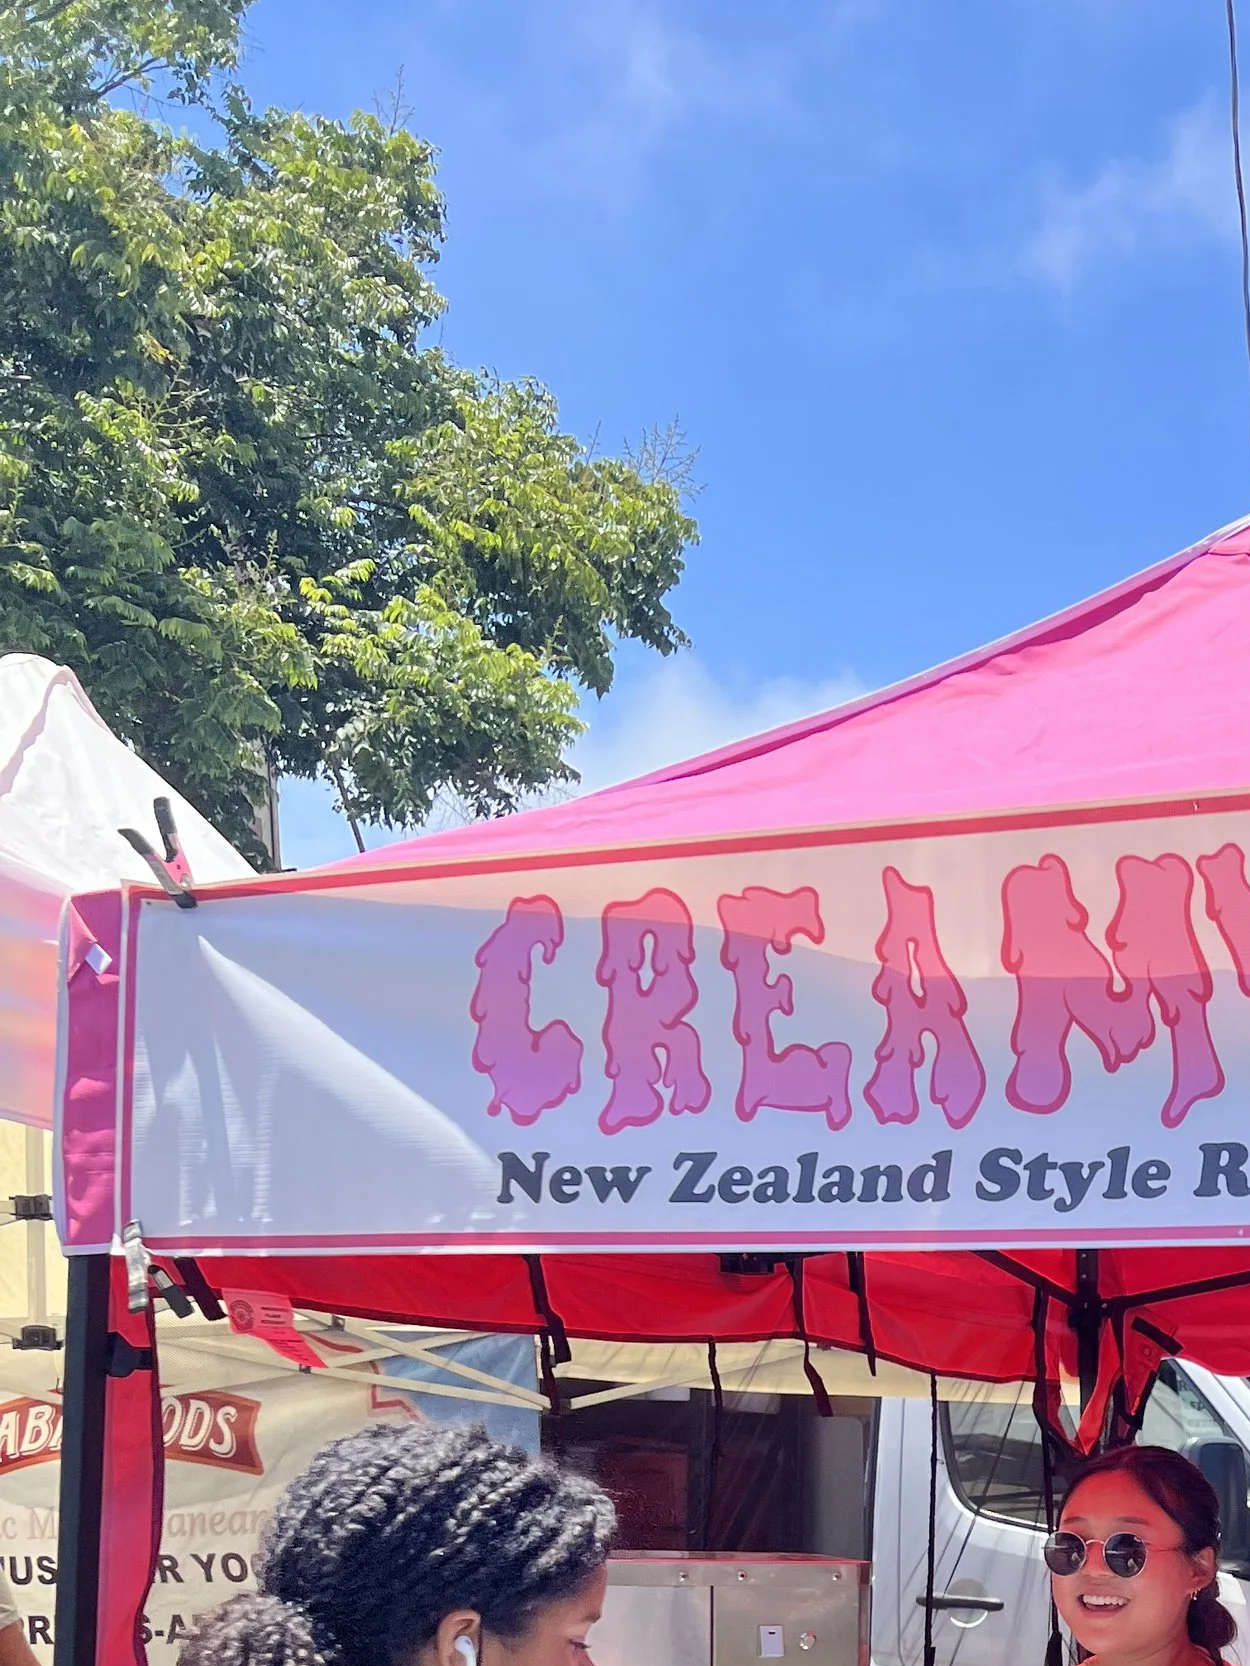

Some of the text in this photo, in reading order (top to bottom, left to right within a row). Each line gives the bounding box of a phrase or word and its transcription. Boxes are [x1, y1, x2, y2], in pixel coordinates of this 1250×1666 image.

[497, 1152, 651, 1205] New
[670, 1149, 953, 1204] Zealand
[975, 1145, 1171, 1213] Style
